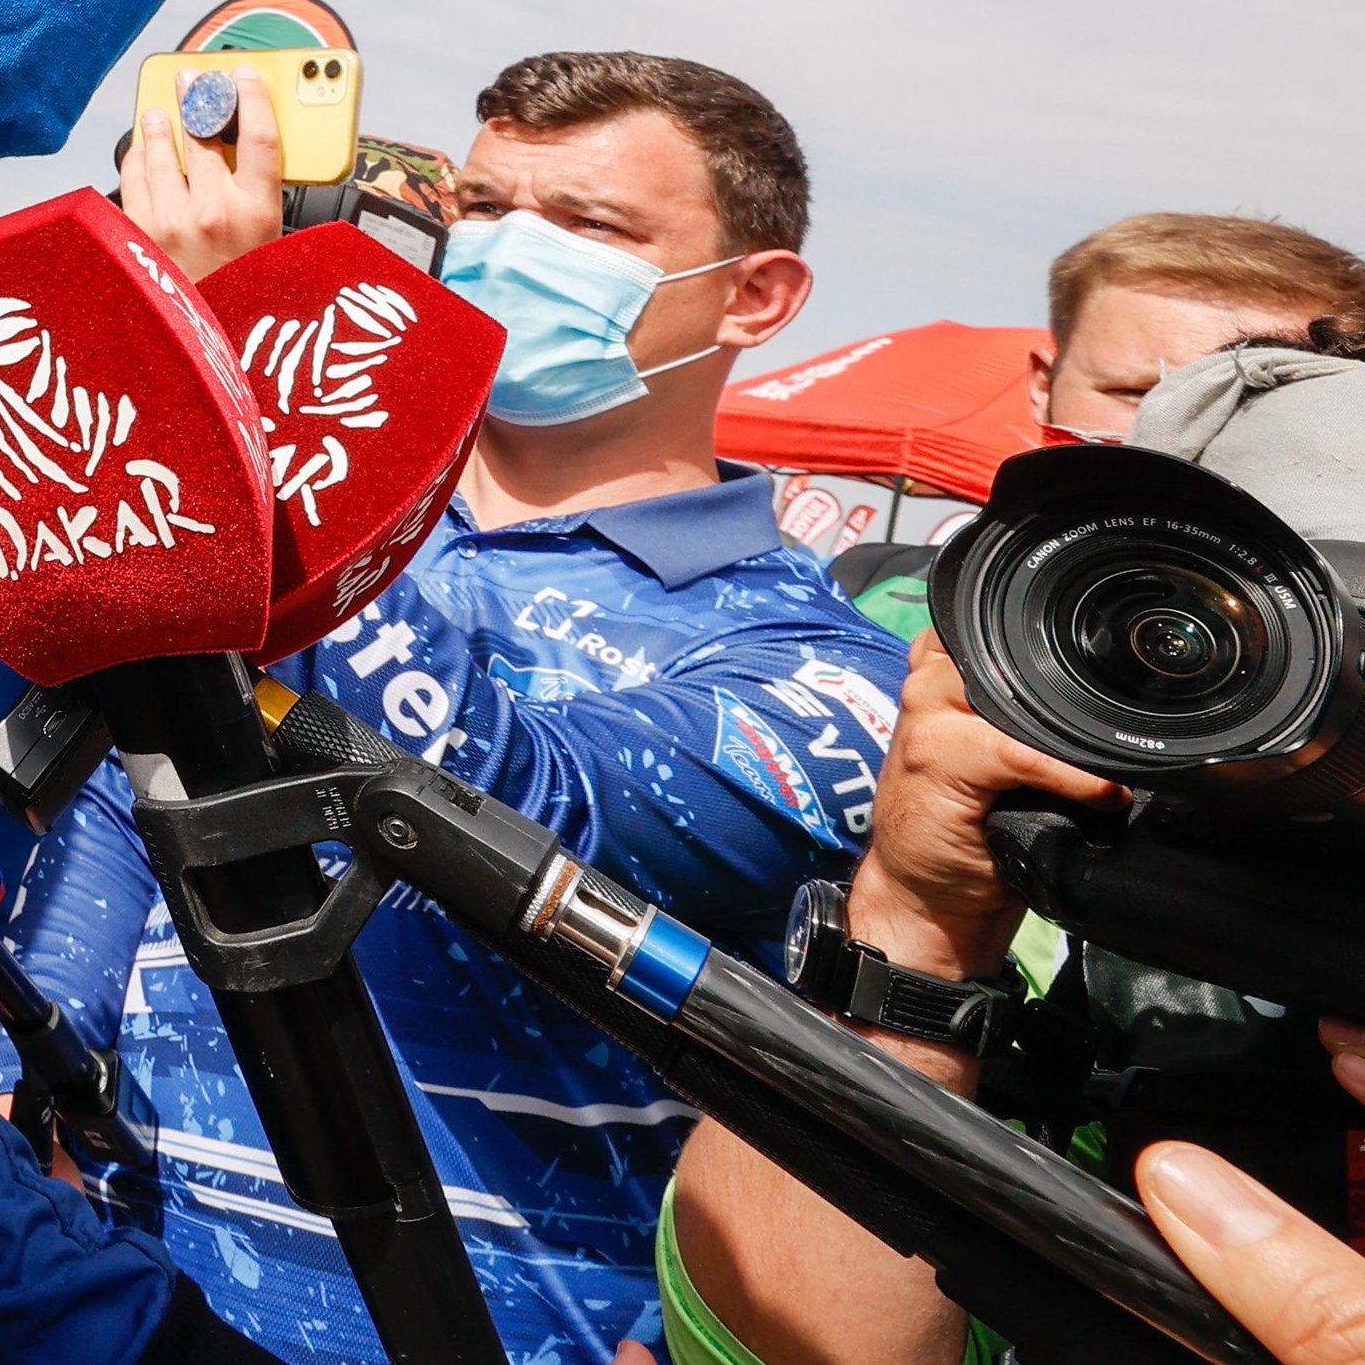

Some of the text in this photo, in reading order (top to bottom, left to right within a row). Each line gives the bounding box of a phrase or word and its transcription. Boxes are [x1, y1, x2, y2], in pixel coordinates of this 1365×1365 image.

[1026, 538, 1061, 570] CANON
[1061, 521, 1099, 543] ZOOM
[1104, 516, 1135, 529] LENS
[1142, 517, 1157, 527] EF
[1166, 520, 1222, 545] 16-35mm
[1228, 543, 1257, 567] 1:2.8
[1274, 585, 1298, 611] USM
